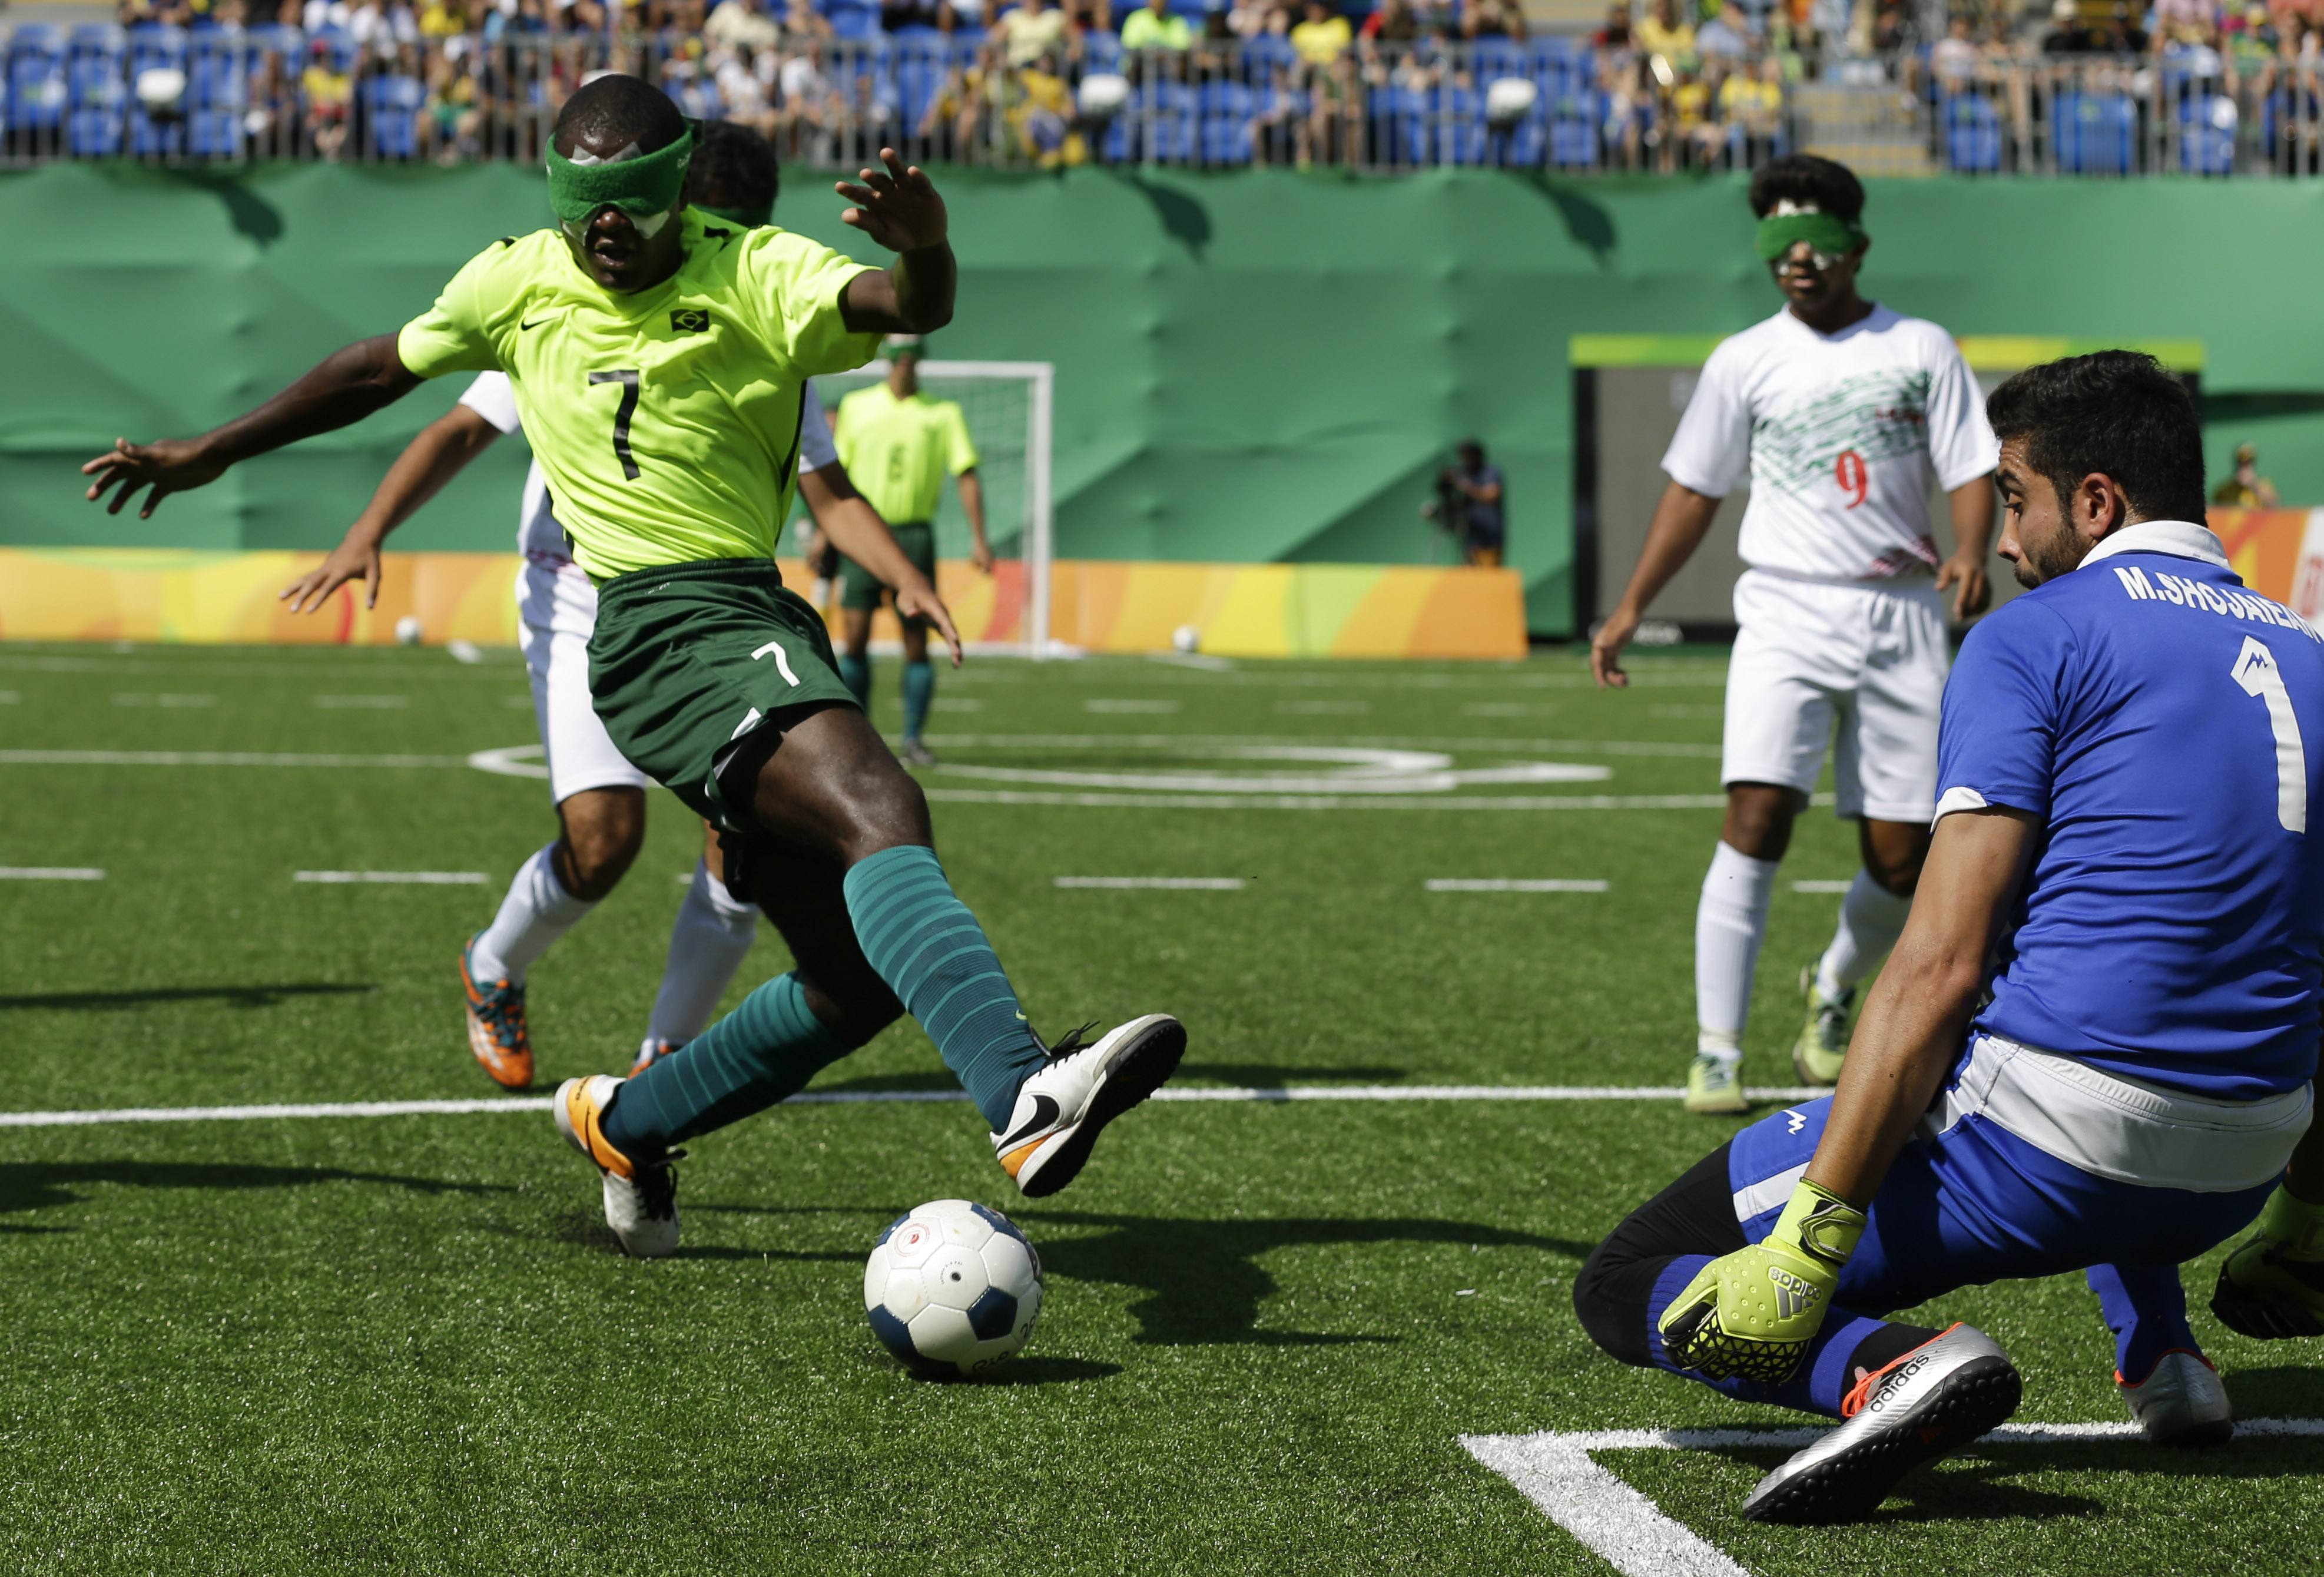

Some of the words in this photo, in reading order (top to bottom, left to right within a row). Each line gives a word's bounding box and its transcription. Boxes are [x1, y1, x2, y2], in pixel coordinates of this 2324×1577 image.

[589, 370, 641, 481] 7
[1835, 450, 1868, 509] 9
[751, 641, 800, 687] 7
[2230, 635, 2307, 834] 1
[1769, 1267, 1822, 1301] adidas
[972, 1350, 1010, 1371] Rio
[1870, 1354, 1930, 1413] adidas
